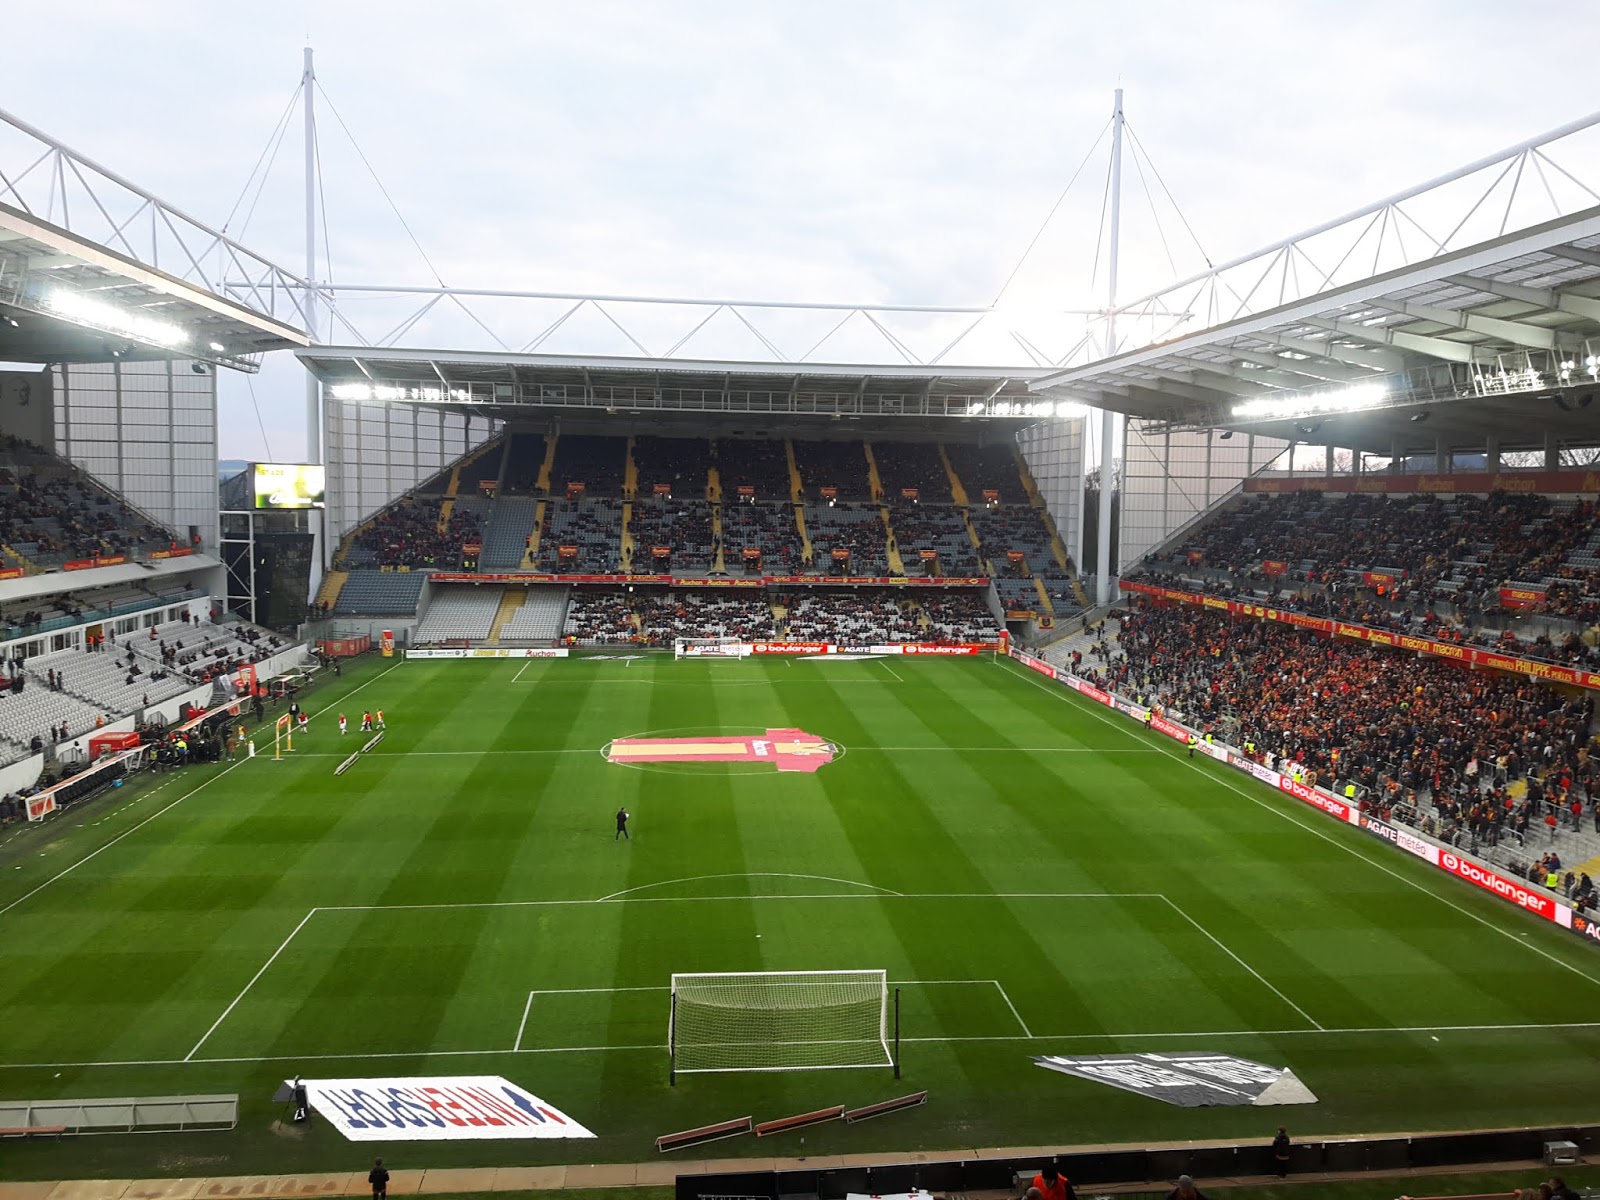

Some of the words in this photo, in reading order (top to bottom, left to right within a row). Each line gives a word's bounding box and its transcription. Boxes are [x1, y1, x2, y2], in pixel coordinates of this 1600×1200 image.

[1493, 474, 1536, 491] Auchan
[1339, 624, 1361, 638] Auchan
[1367, 629, 1391, 644] Auchan
[769, 645, 823, 653] boulanger
[918, 646, 972, 654] boulanger
[1401, 637, 1429, 651] macron
[1433, 643, 1463, 658] macron
[1515, 660, 1550, 678] PHILIPPE
[1155, 718, 1187, 741] boulanger
[1232, 756, 1253, 772] AGATE
[1293, 782, 1345, 816] boulanger
[1366, 819, 1397, 841] AGATE
[1397, 833, 1426, 855] météo
[1460, 861, 1546, 911] boulanger
[317, 1086, 538, 1128] INTERSPORT
